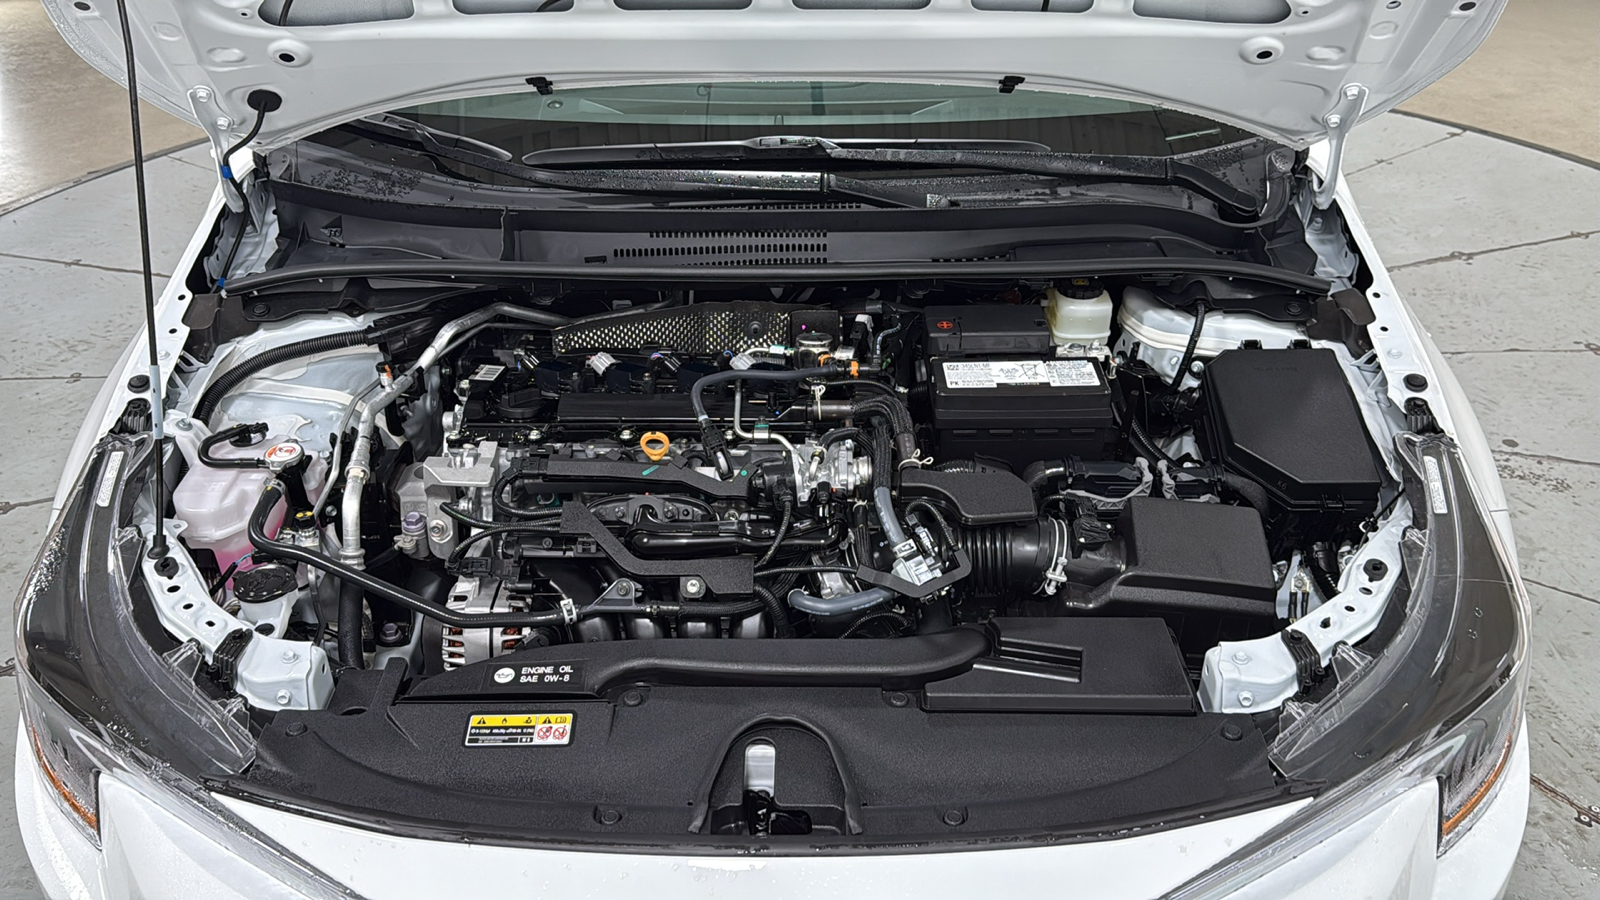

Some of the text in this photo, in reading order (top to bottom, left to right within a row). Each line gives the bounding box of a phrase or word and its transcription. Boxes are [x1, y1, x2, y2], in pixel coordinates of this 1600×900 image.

[521, 665, 574, 675] ENGINE OIL
[520, 674, 570, 683] SAE 0W-8
